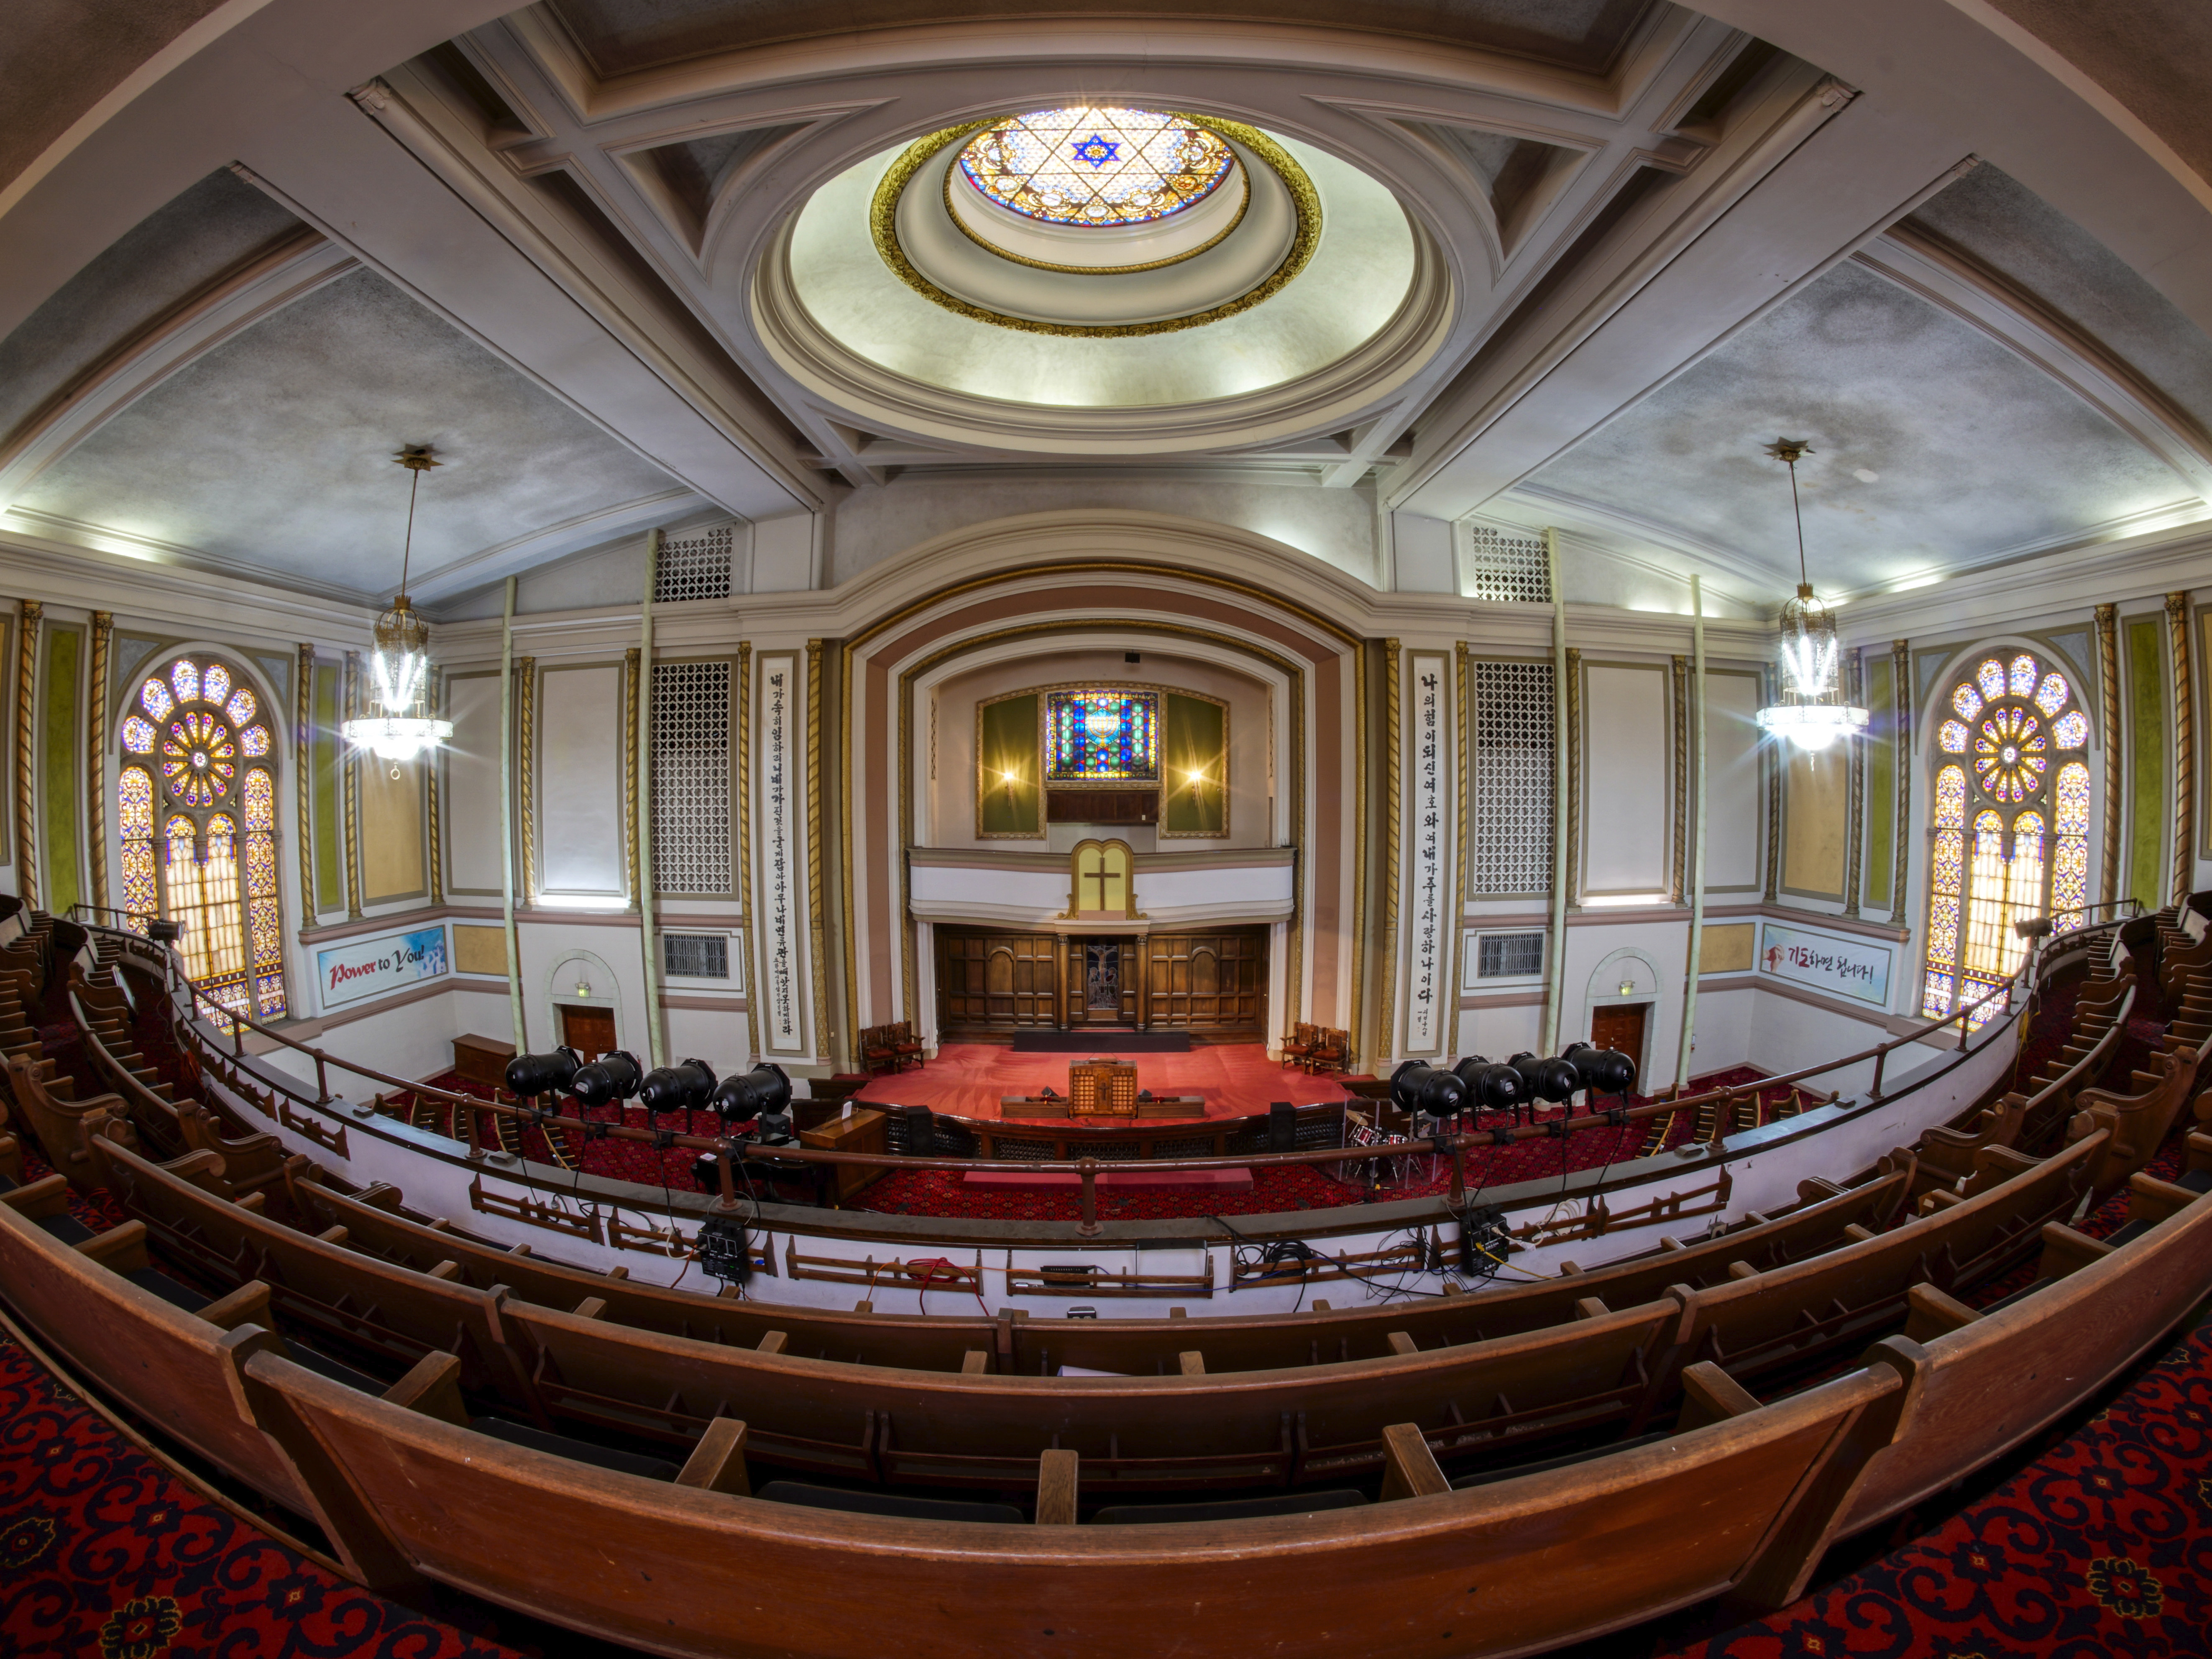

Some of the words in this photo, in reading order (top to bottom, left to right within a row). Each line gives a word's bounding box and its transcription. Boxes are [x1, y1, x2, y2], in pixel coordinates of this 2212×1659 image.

[330, 961, 376, 990] Power
[378, 958, 390, 971] to
[391, 944, 424, 973] You!
[1788, 946, 1833, 971] 기도하면
[1836, 956, 1874, 984] 됩니다!
